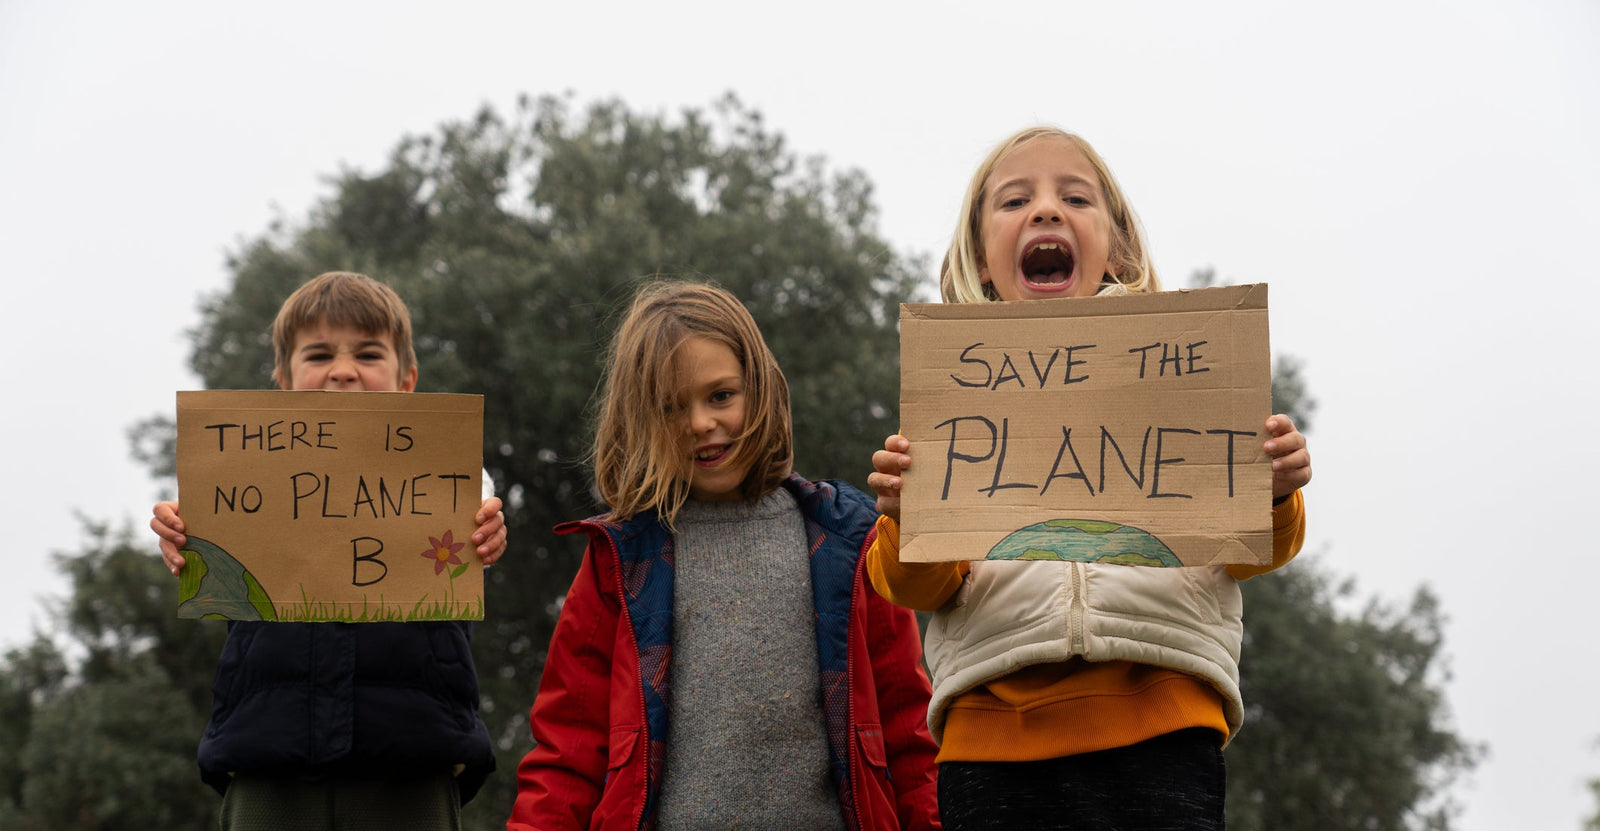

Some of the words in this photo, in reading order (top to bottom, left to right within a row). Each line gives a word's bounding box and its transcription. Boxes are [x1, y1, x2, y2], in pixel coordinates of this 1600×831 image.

[950, 342, 1096, 390] SAVE
[1128, 340, 1210, 378] THE
[205, 420, 338, 452] THERE
[385, 423, 414, 452] IS
[935, 415, 1257, 500] PLANET
[214, 485, 262, 514] NO
[290, 472, 470, 520] PLANET
[350, 536, 388, 587] B
